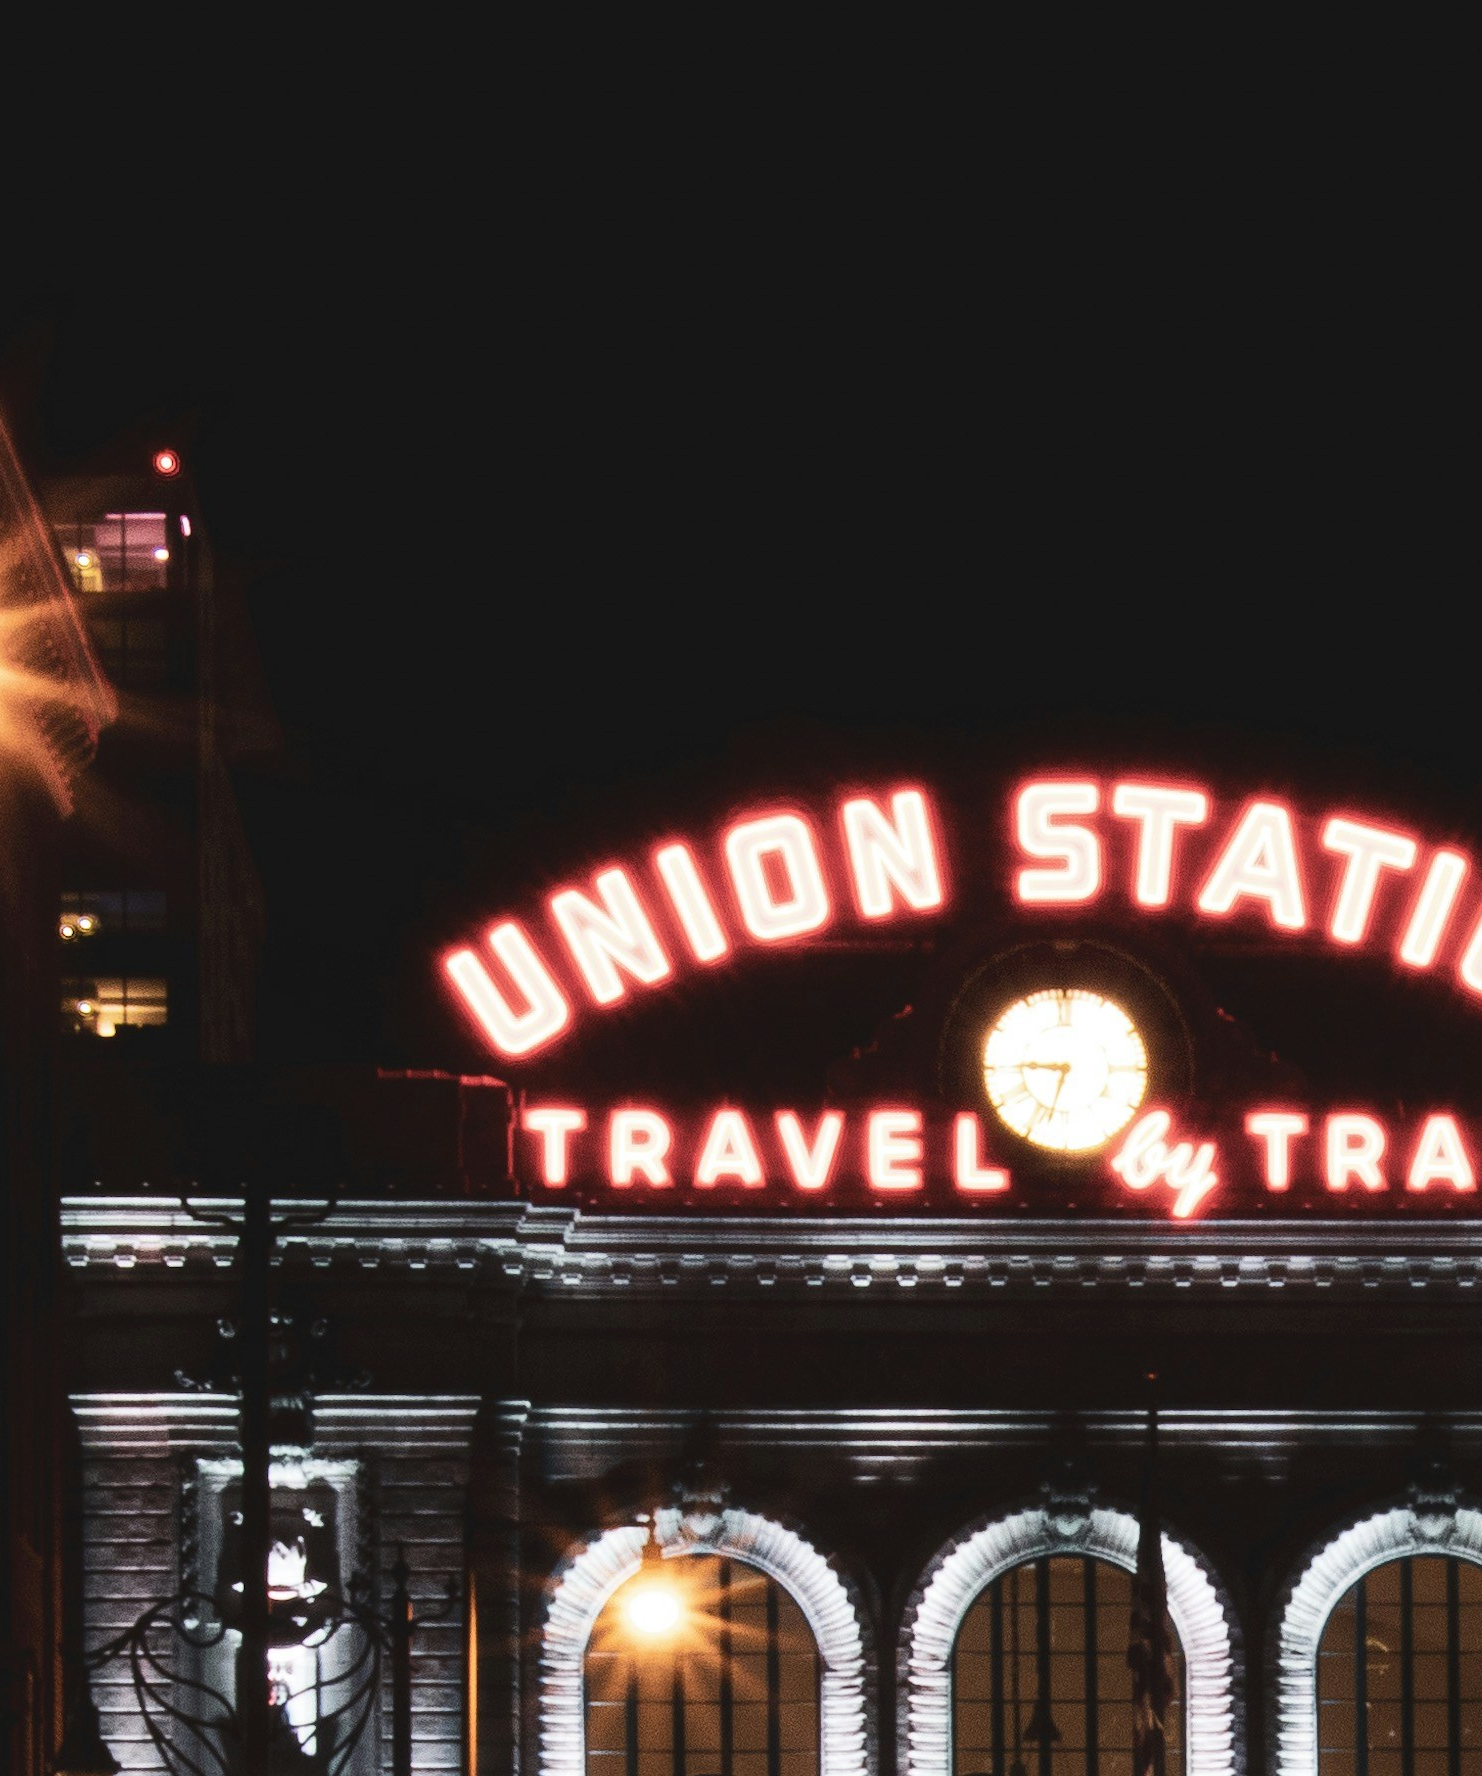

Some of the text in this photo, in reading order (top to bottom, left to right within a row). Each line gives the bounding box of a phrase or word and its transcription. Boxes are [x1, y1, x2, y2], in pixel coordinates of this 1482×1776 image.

[441, 788, 945, 1061] UNION
[521, 1107, 1009, 1190] TRAVEL
[1112, 1110, 1217, 1218] by
